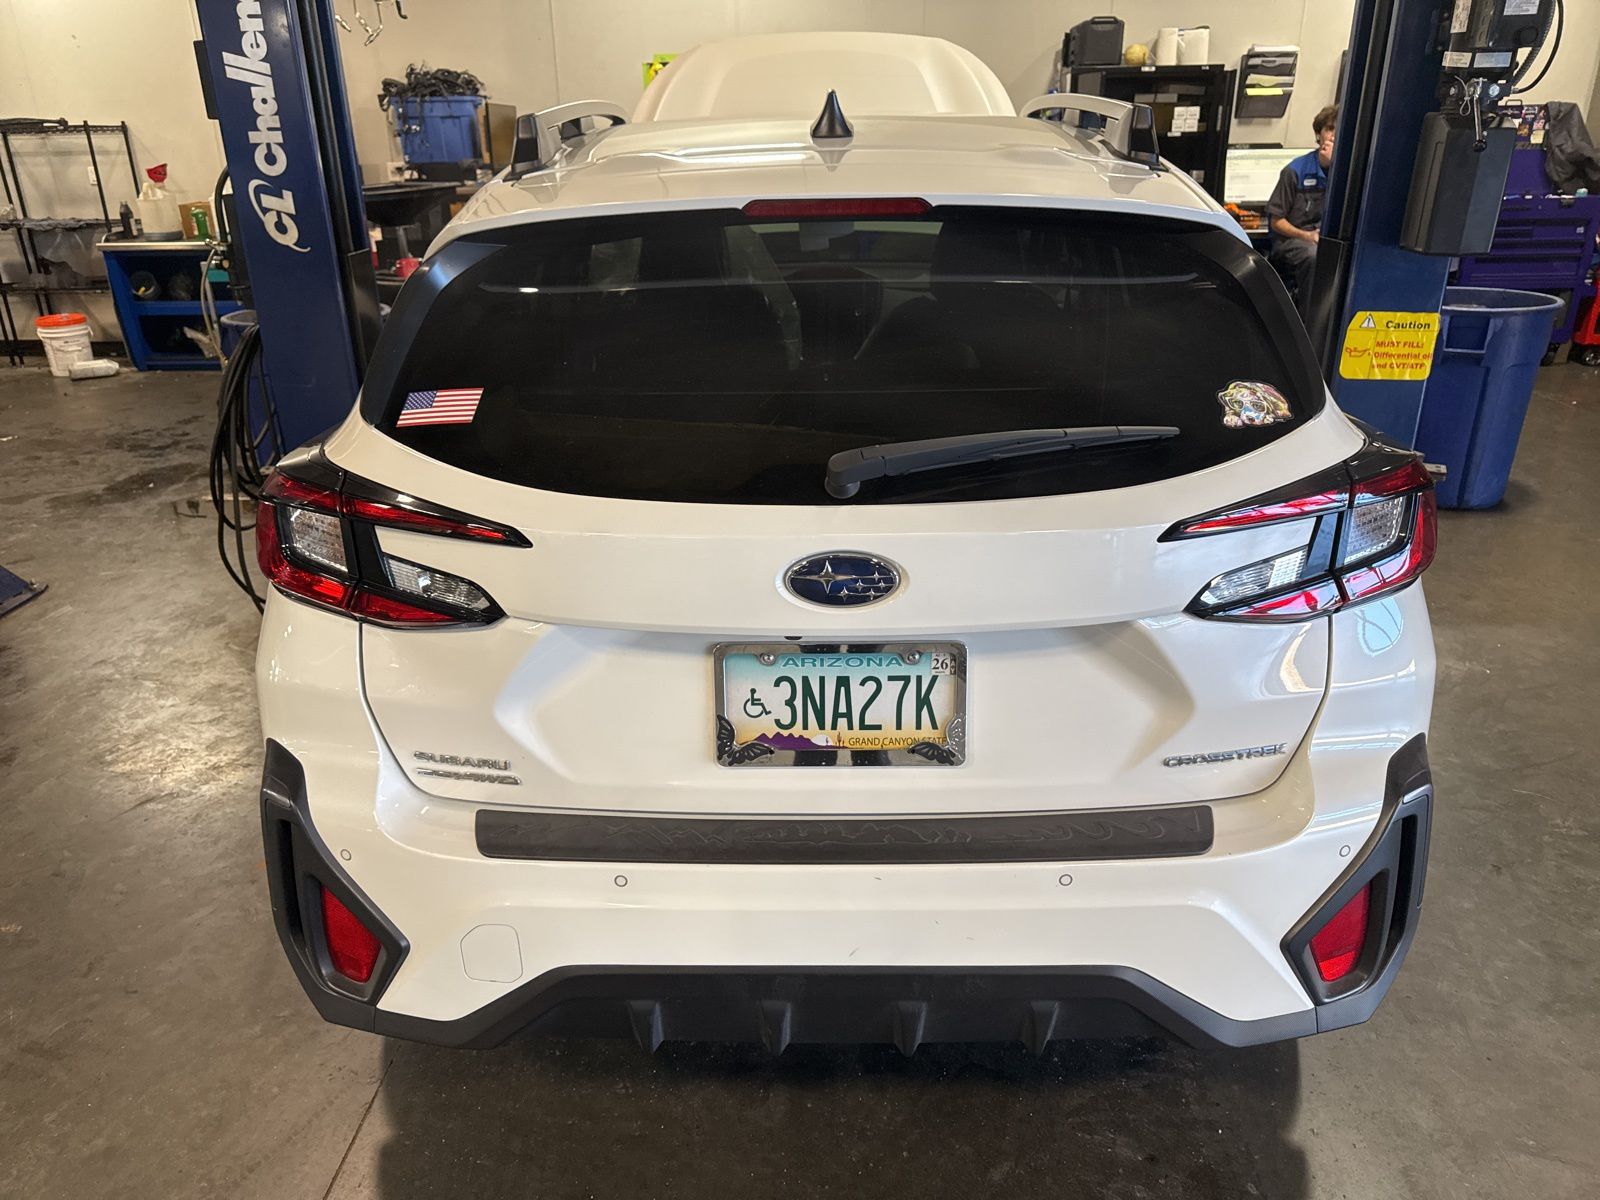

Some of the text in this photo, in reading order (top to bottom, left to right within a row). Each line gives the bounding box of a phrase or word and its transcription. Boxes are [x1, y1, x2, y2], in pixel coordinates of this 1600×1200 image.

[1385, 320, 1430, 330] Caution
[1375, 340, 1424, 349] MUST FILL:
[1374, 351, 1421, 360] Differential
[782, 656, 903, 668] ARIZONA
[931, 657, 949, 670] 26
[774, 675, 939, 731] 3NA27K
[848, 737, 880, 747] GRAND
[882, 737, 920, 747] CANYON
[413, 750, 511, 771] SUBARU
[1163, 742, 1287, 767] CROSSTREK
